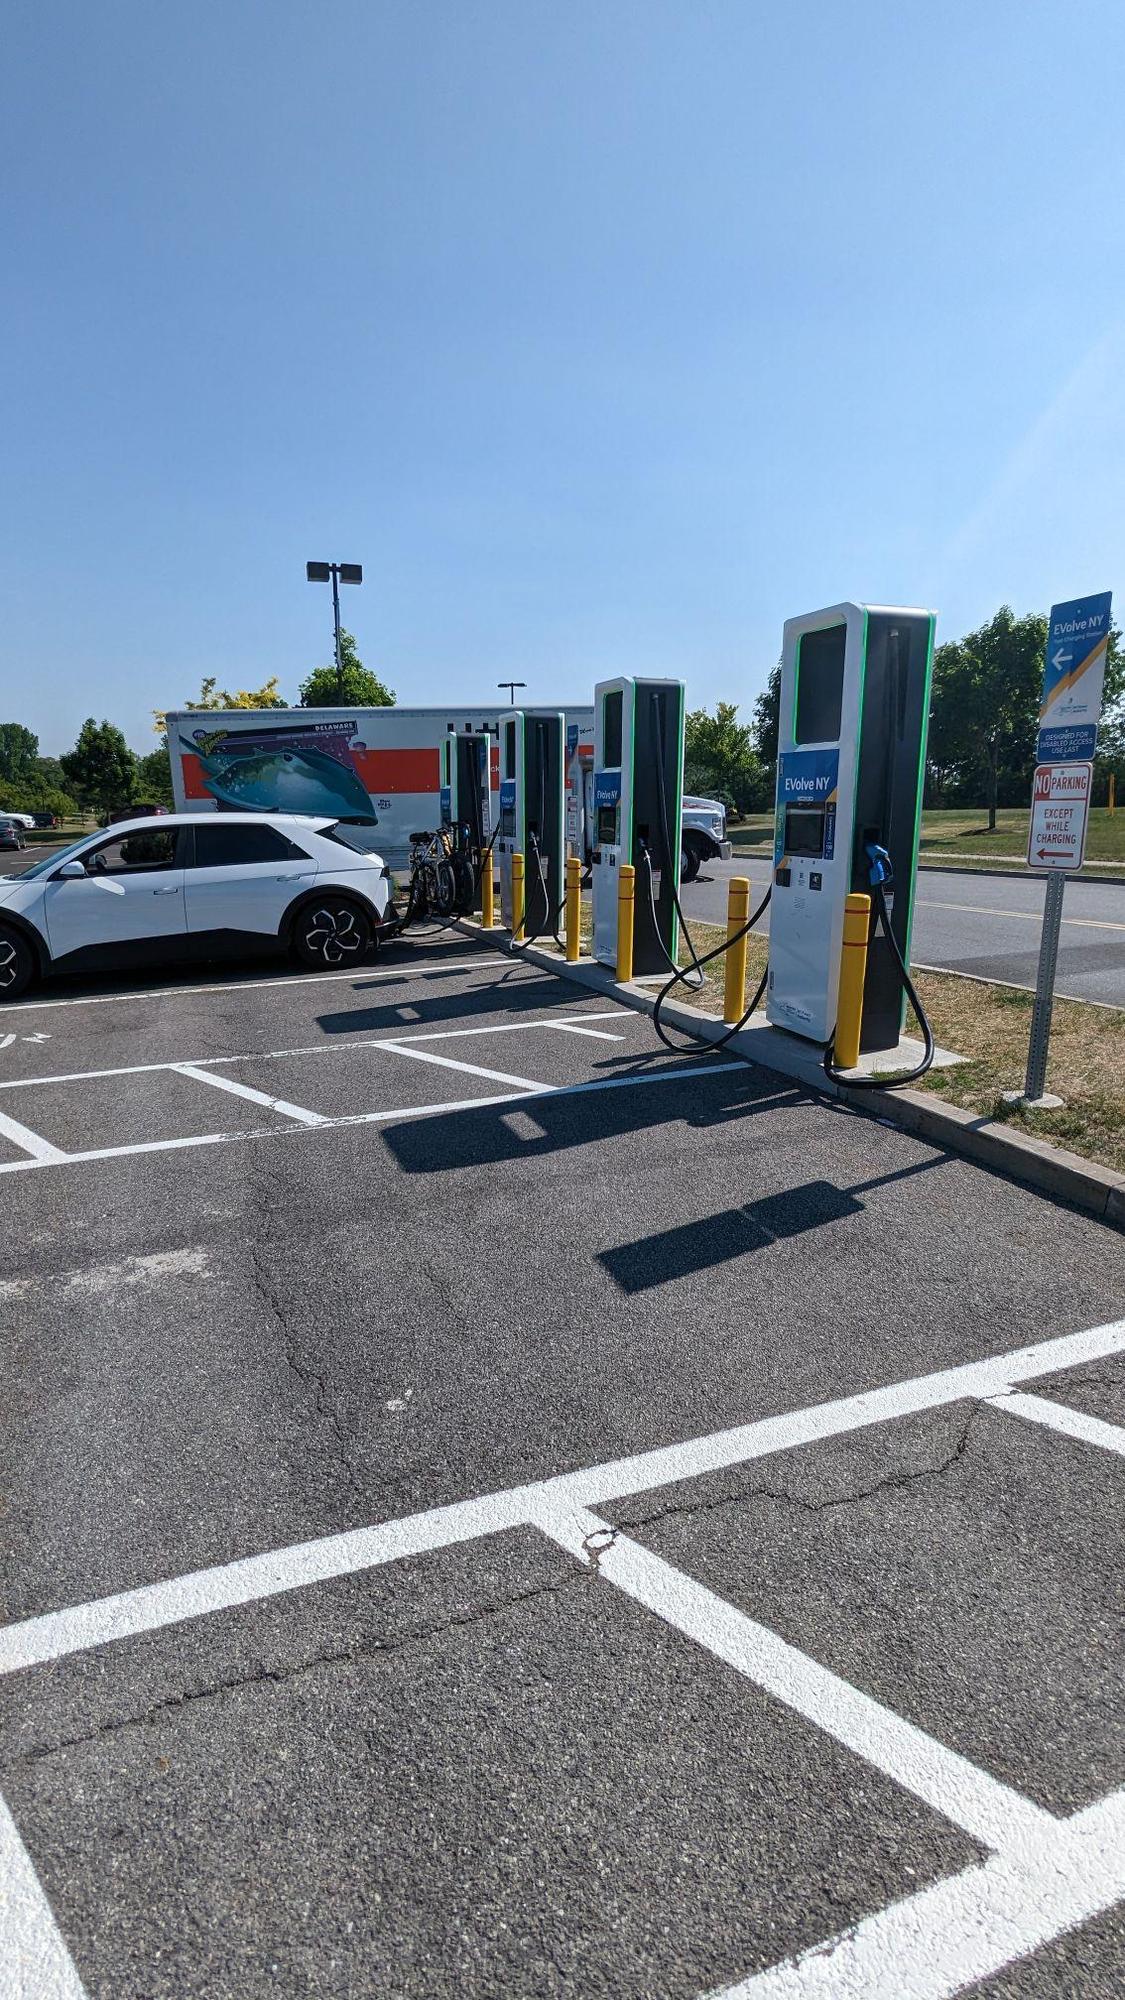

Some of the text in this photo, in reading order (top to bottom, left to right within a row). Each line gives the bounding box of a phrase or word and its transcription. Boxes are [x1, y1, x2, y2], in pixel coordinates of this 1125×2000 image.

[1054, 614, 1104, 635] EVolve NY
[314, 722, 353, 732] DELAWARE
[1045, 730, 1089, 741] DESIGNED FOR
[1040, 737, 1093, 748] DISABLED ACCESS
[1051, 746, 1064, 754] USE
[785, 776, 830, 791] EVolve NY
[1035, 775, 1086, 793] NO PARKING
[1045, 808, 1073, 818] EXCEPT
[1046, 822, 1069, 831] WHILE
[1037, 834, 1076, 844] CHARGING
